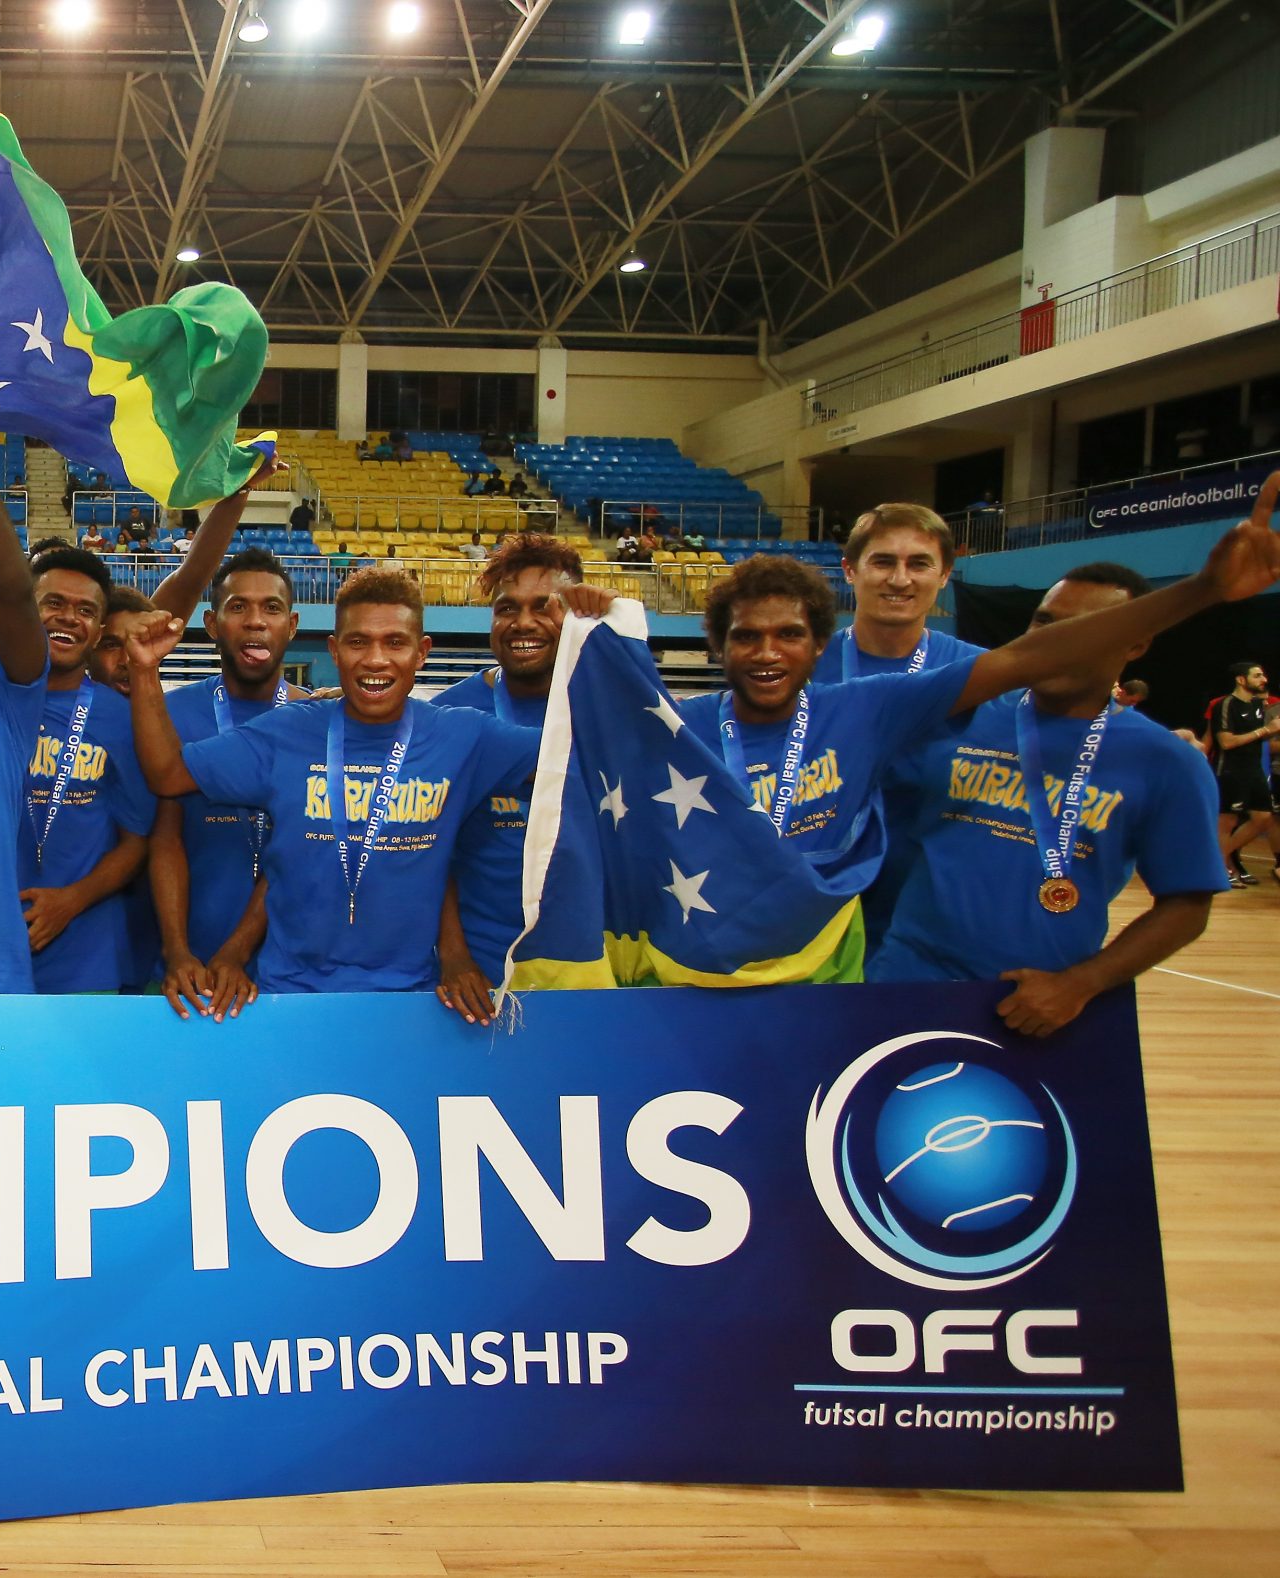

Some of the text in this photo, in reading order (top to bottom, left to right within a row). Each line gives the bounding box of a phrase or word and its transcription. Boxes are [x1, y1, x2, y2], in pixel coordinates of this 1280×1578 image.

[1096, 483, 1266, 518] OFC oceaniafootball.c
[71, 704, 89, 733] 2016
[792, 711, 809, 739] OFC
[63, 735, 81, 763] OFC
[385, 741, 406, 774] 2016
[779, 741, 804, 784] Futsal
[1079, 733, 1101, 762] OFC
[51, 764, 71, 805] Futsal
[375, 775, 395, 806] OFC
[1064, 764, 1091, 806] Futsal
[363, 807, 385, 851] Futsal
[830, 1309, 1082, 1374] OFC
[84, 1331, 628, 1408] CHAMPIONSHIP
[804, 1401, 1115, 1436] futsal championship
